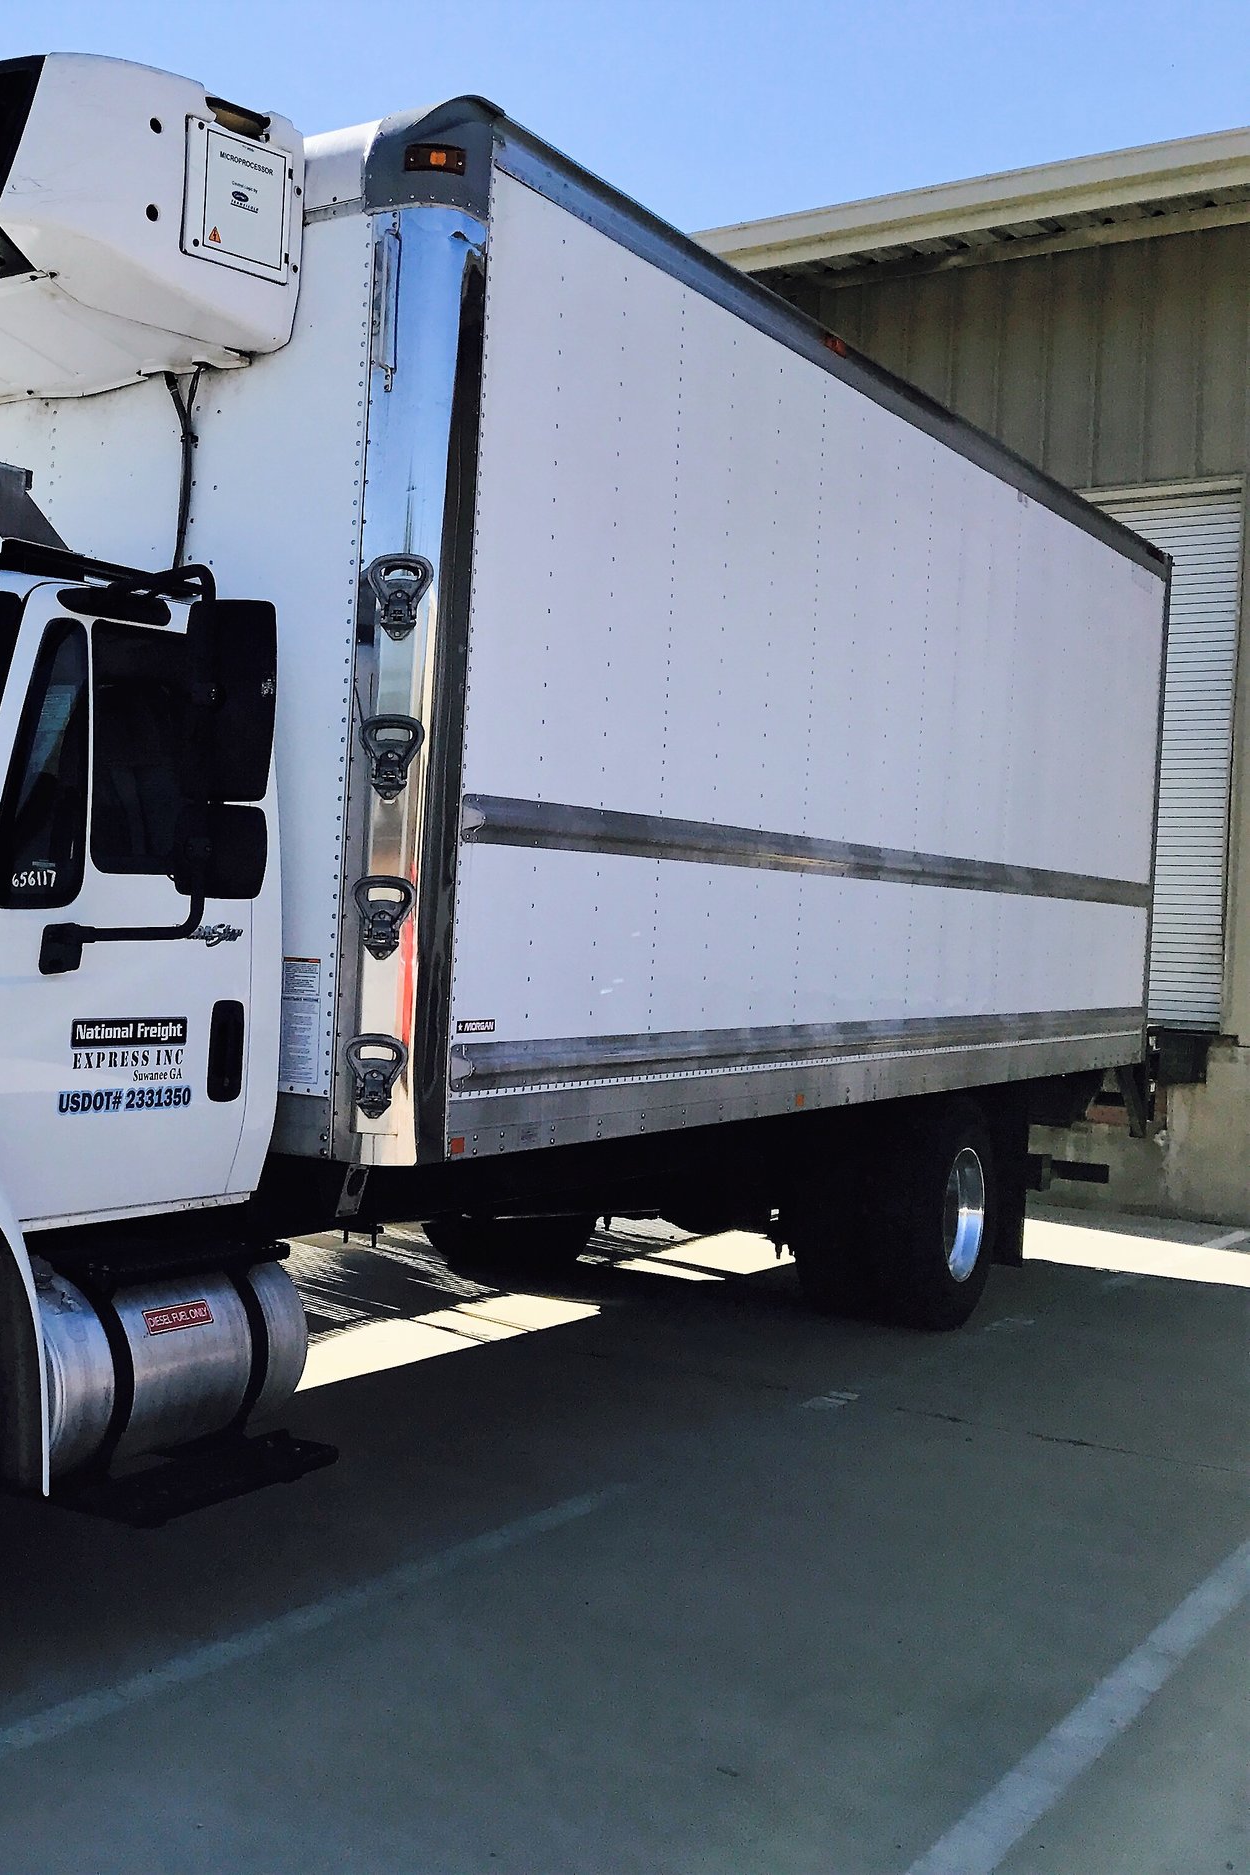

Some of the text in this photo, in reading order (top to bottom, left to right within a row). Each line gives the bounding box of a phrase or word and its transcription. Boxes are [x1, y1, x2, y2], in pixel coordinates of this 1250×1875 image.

[220, 151, 273, 176] MICROPROCESSOR
[12, 869, 56, 887] 656117
[76, 1023, 182, 1041] National Freight
[462, 1021, 494, 1032] MORGAN
[73, 1049, 184, 1069] EXPRESS INC
[133, 1068, 182, 1081] Suwanee GA
[58, 1087, 191, 1113] USDOT# 2331350
[148, 1307, 207, 1328] DIESEL FUEL ONLY
